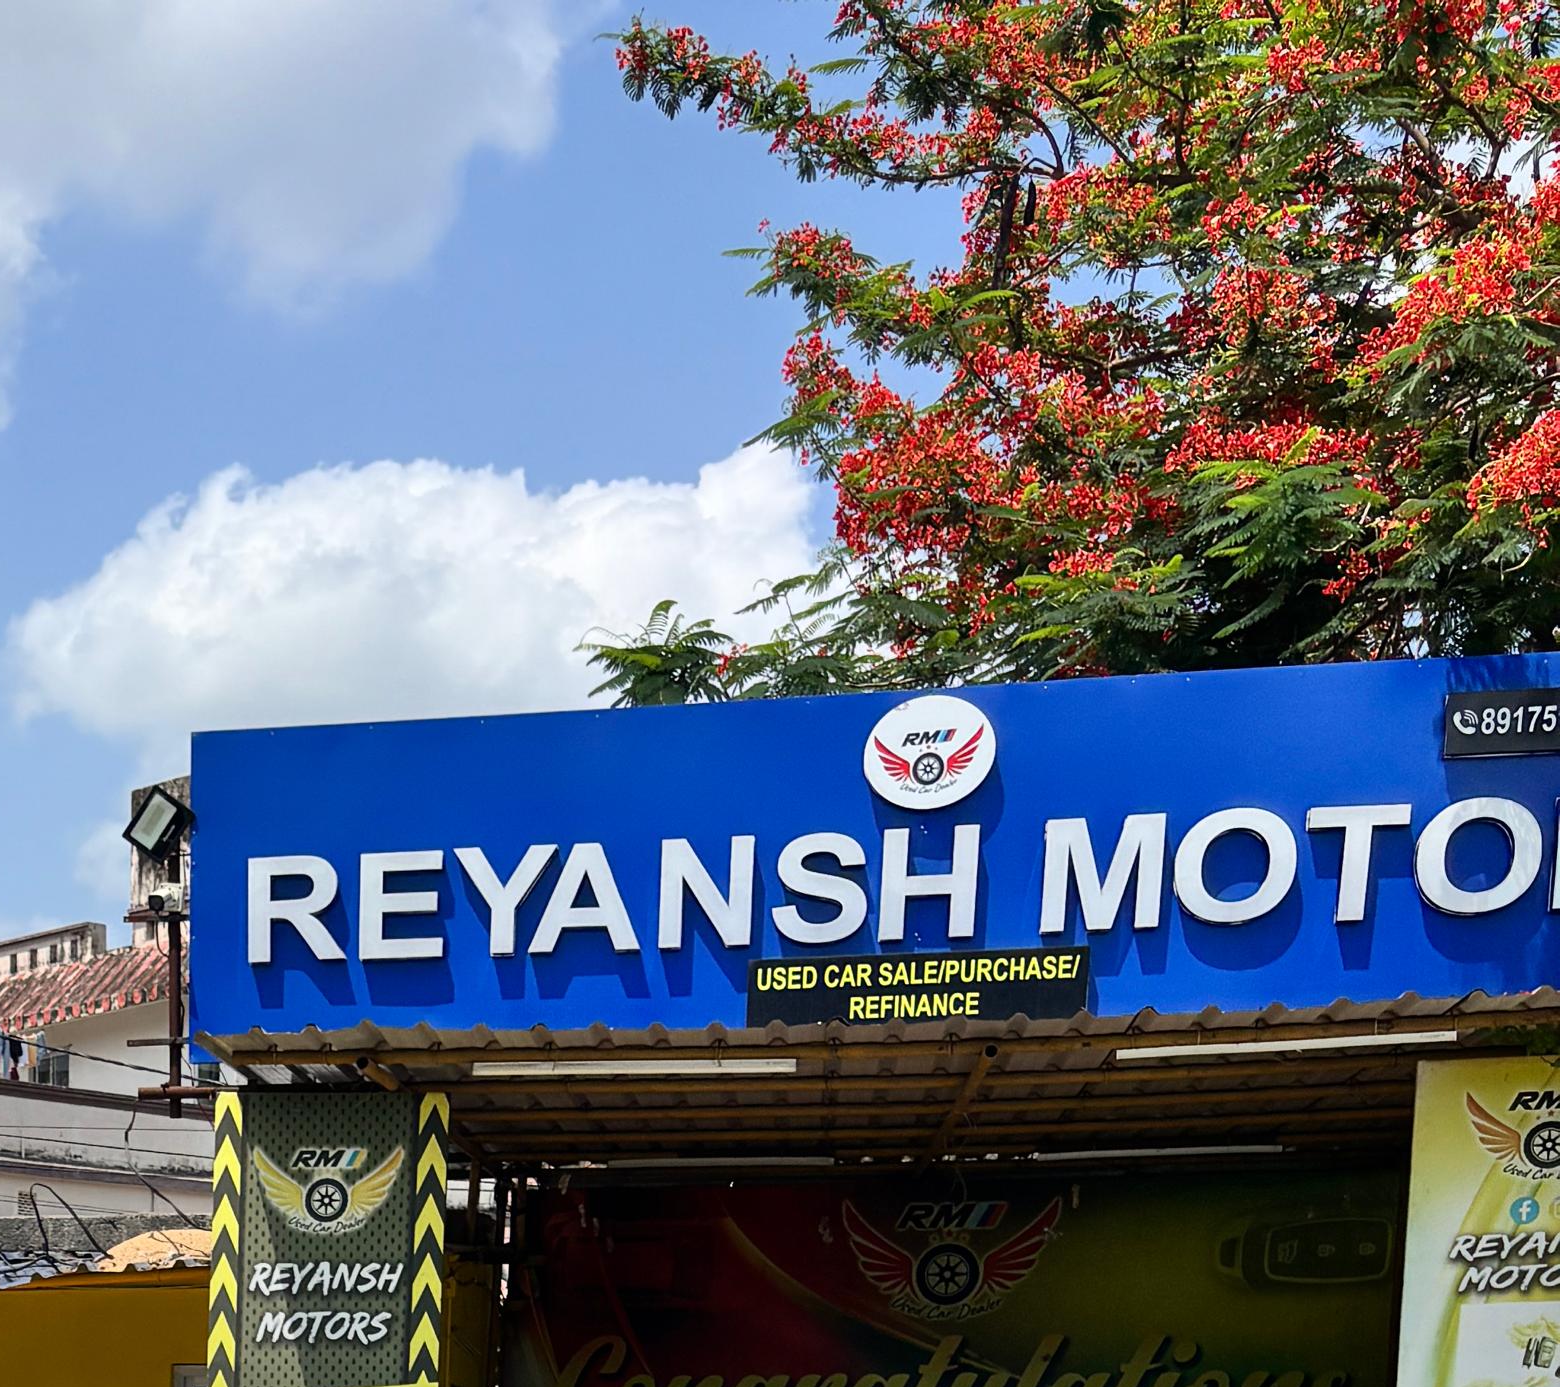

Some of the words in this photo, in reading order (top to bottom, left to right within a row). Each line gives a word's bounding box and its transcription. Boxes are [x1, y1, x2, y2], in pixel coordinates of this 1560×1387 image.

[1481, 704, 1560, 735] 89175
[246, 823, 982, 965] REYANSH
[756, 966, 817, 991] USED
[824, 963, 872, 988] CAR
[878, 954, 1081, 986] SALE/PURCHASE/
[848, 992, 980, 1020] REFINANCE
[248, 1261, 406, 1296] REYANSH
[255, 1310, 393, 1345] MOTORS
